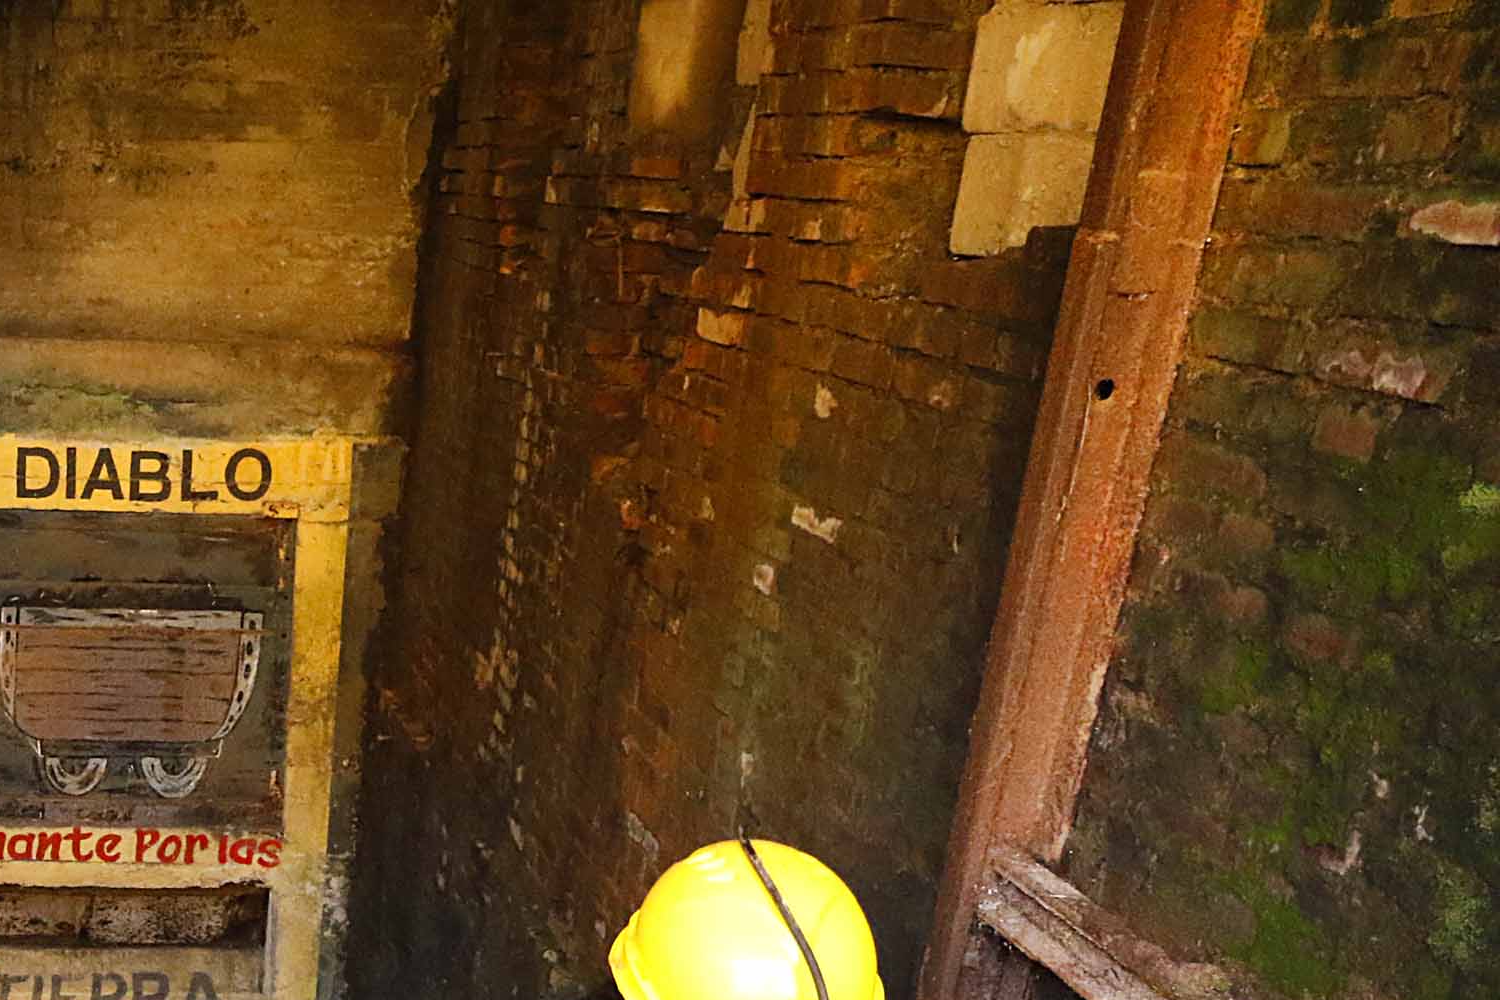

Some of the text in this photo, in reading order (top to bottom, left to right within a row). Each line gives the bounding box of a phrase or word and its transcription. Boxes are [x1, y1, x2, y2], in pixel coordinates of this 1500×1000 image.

[15, 447, 272, 502] DIABLO
[134, 828, 210, 865] Por
[216, 833, 284, 868] las
